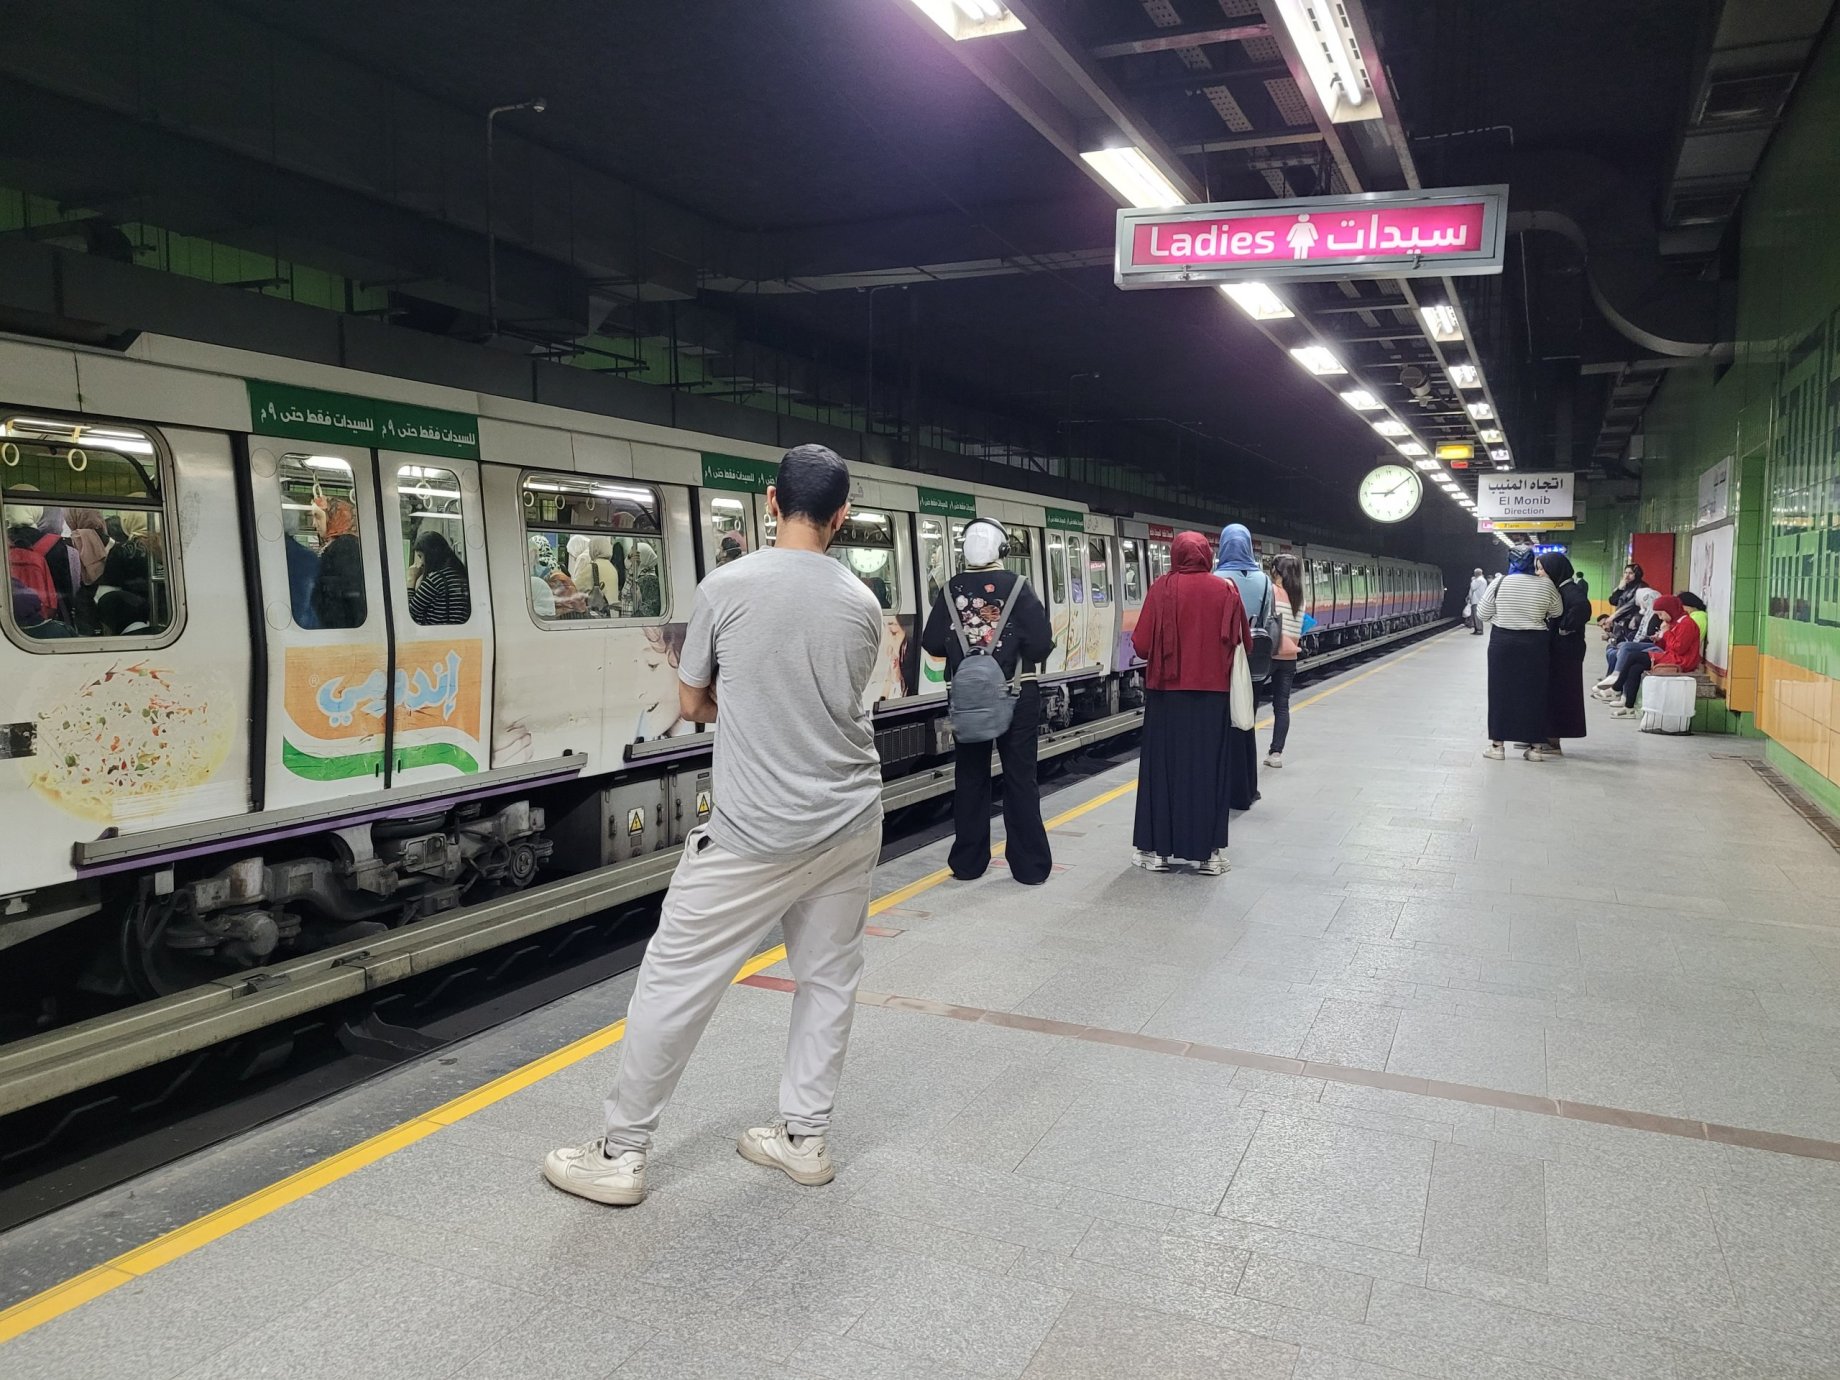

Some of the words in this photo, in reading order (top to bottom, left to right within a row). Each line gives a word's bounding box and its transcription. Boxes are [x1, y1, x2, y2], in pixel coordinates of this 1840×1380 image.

[1150, 224, 1275, 257] Ladies
[1326, 213, 1468, 255] سيدات
[279, 406, 304, 423] حتى
[306, 409, 332, 426] فقط
[333, 413, 374, 434] للسيدات
[397, 422, 418, 438] حتى
[419, 425, 441, 441] فقط
[442, 428, 476, 447] للسيدات
[1488, 479, 1527, 494] المنيب
[1530, 477, 1563, 493] اتجاه
[1499, 496, 1510, 505] El
[1514, 496, 1551, 505] Monib
[1504, 507, 1545, 515] Direction
